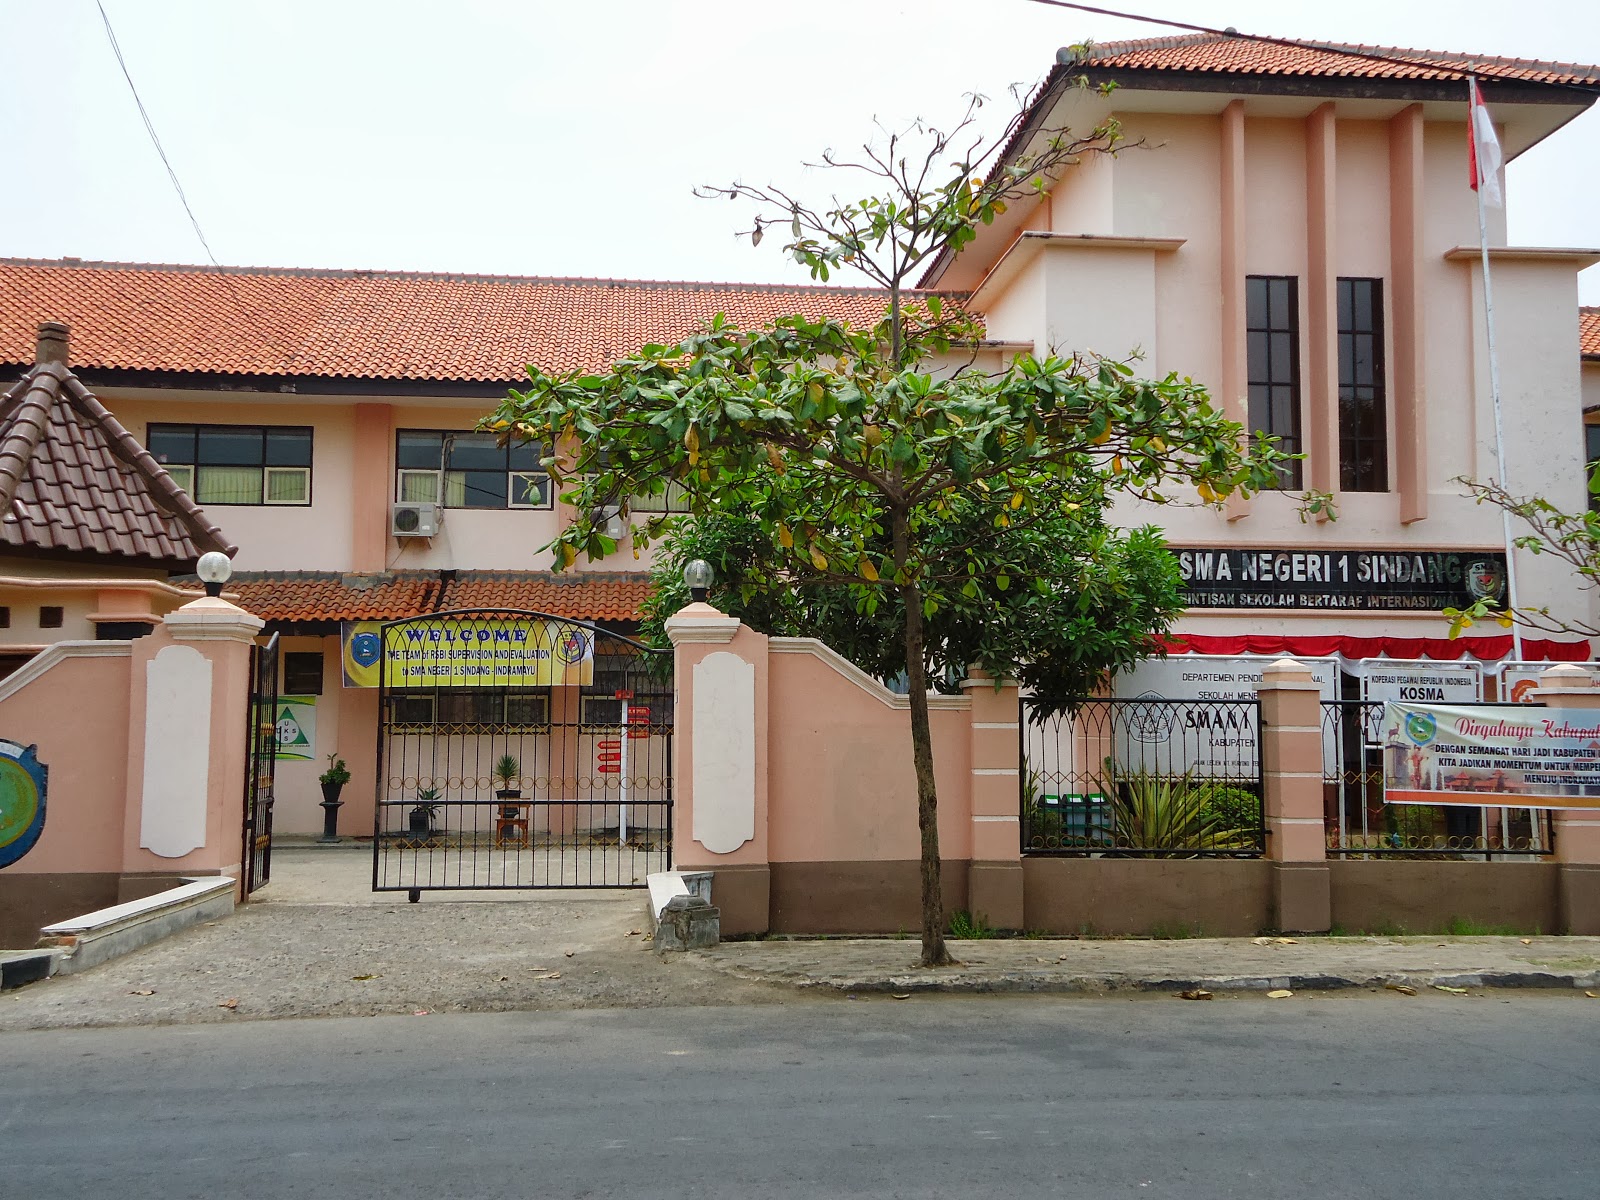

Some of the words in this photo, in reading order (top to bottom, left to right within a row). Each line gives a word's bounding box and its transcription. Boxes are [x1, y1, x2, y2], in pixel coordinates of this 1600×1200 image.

[1179, 552, 1232, 581] SMA
[1241, 553, 1331, 582] NEGERI
[1338, 554, 1349, 582] 1
[1356, 554, 1461, 584] SINDANG
[1239, 593, 1295, 606] SEKOLAH
[1299, 594, 1363, 607] BERTARAF
[1367, 595, 1462, 608] INTERNASIONAL
[405, 630, 526, 642] WELCOME
[387, 650, 400, 660] THE
[402, 650, 420, 660] TEAM
[422, 650, 429, 660] of
[431, 650, 446, 660] RSBI
[448, 649, 493, 660] SUPERVISION
[495, 649, 509, 660] AND
[511, 649, 550, 660] EVALUATION
[411, 666, 426, 676] SMA
[428, 666, 451, 676] NEGER
[454, 666, 459, 676] 1
[460, 665, 490, 676] SNDANG
[495, 665, 536, 676] INDRAMAYU
[1182, 672, 1235, 682] DEPARTEMEN
[1238, 673, 1263, 683] PENDID
[1371, 675, 1397, 684] KOPERASI
[1397, 676, 1419, 685] PEGAWAI
[1420, 676, 1444, 686] REPUBLIK
[1445, 677, 1472, 686] INDONESIA
[1198, 691, 1234, 700] SEKOLAH
[1237, 692, 1258, 700] MENE
[1400, 687, 1445, 701] KOSMA
[1185, 710, 1237, 728] SMAN
[1455, 717, 1534, 741] Dirgahayu
[1538, 719, 1600, 743] Kabupat
[1208, 738, 1256, 748] KABUPATEN
[1435, 744, 1466, 754] DENGAN
[1468, 745, 1509, 756] SEMANGAT
[1512, 747, 1531, 757] HARI
[1533, 747, 1551, 757] JADI
[1553, 748, 1596, 758] KABUPATEN
[1438, 757, 1456, 767] KITA
[1459, 758, 1491, 768] JADIKAN
[1494, 759, 1542, 770] MOMENTUM
[1544, 761, 1571, 771] UNTUK
[1524, 774, 1557, 784] MENUJU
